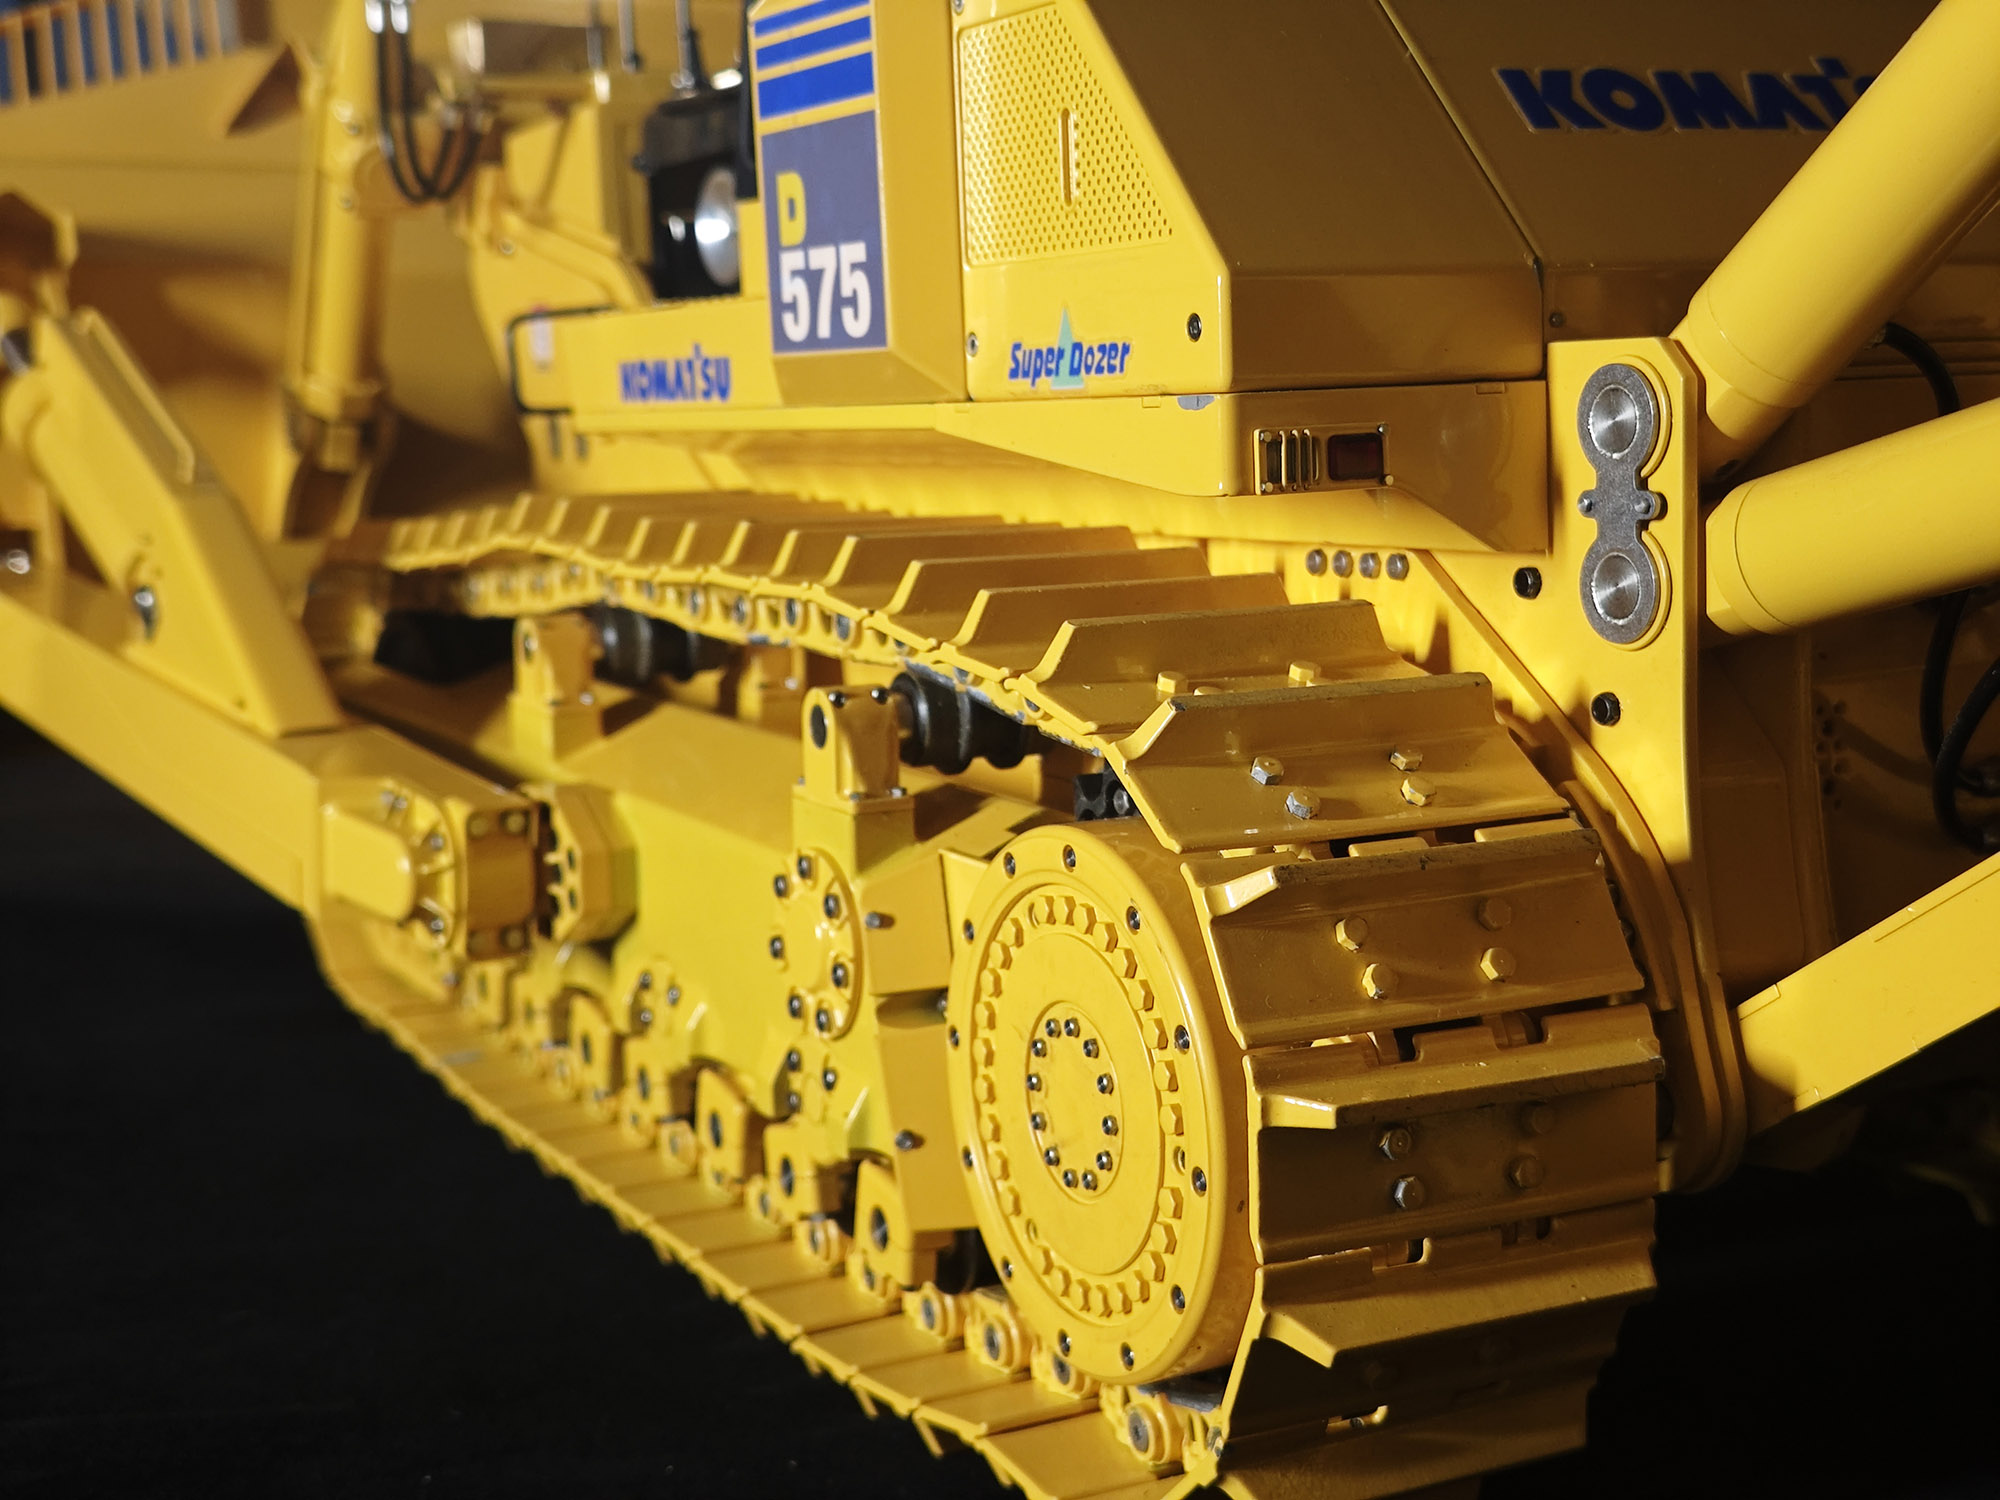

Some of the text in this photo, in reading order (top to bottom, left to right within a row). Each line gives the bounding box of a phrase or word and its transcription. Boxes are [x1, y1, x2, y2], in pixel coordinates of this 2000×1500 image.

[1496, 57, 1876, 132] KOMAT
[776, 171, 807, 248] D
[779, 240, 872, 342] 575
[620, 342, 731, 402] KOMATSU
[1008, 341, 1130, 388] Super Dozer
